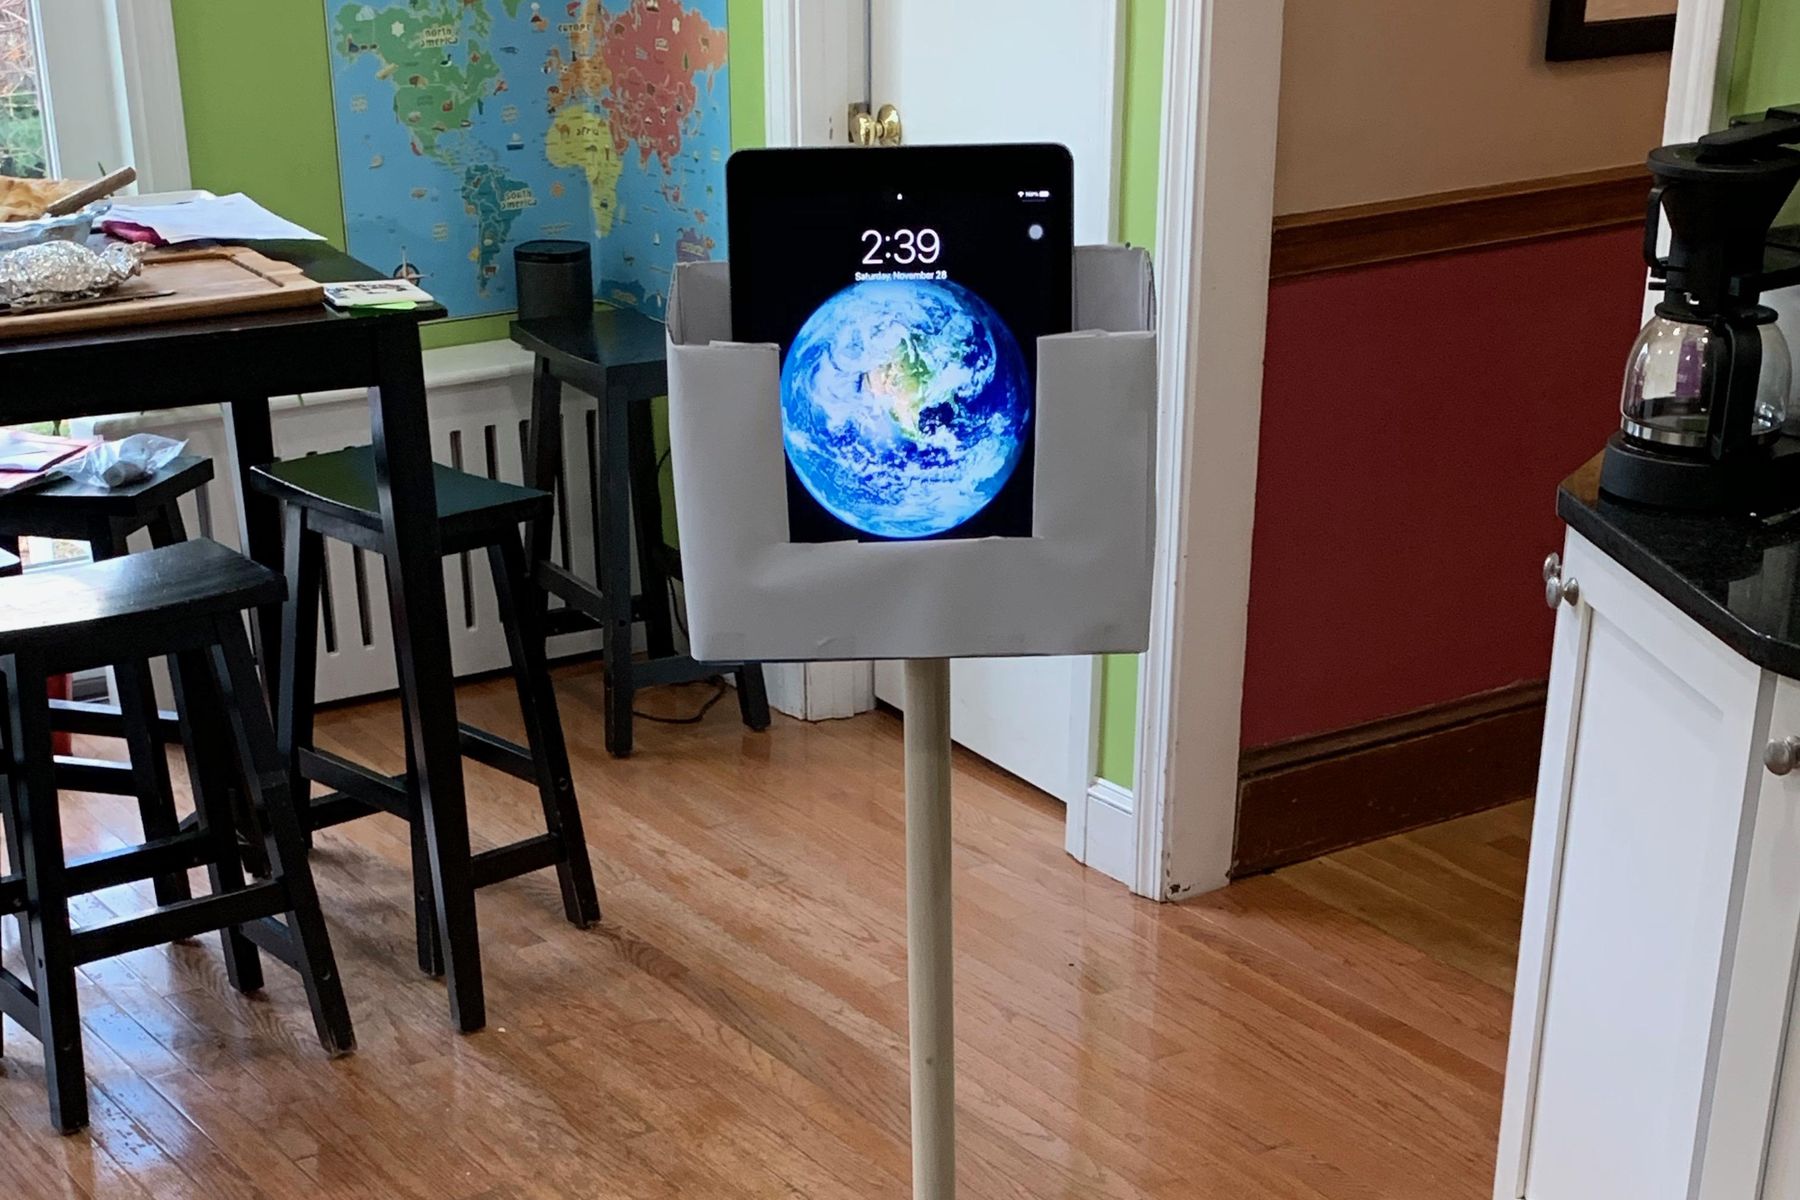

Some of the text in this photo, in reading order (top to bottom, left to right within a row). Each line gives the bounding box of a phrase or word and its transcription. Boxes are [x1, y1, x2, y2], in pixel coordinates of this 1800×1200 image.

[861, 228, 941, 265] 2:39
[855, 270, 947, 281] Saturday, November 28
